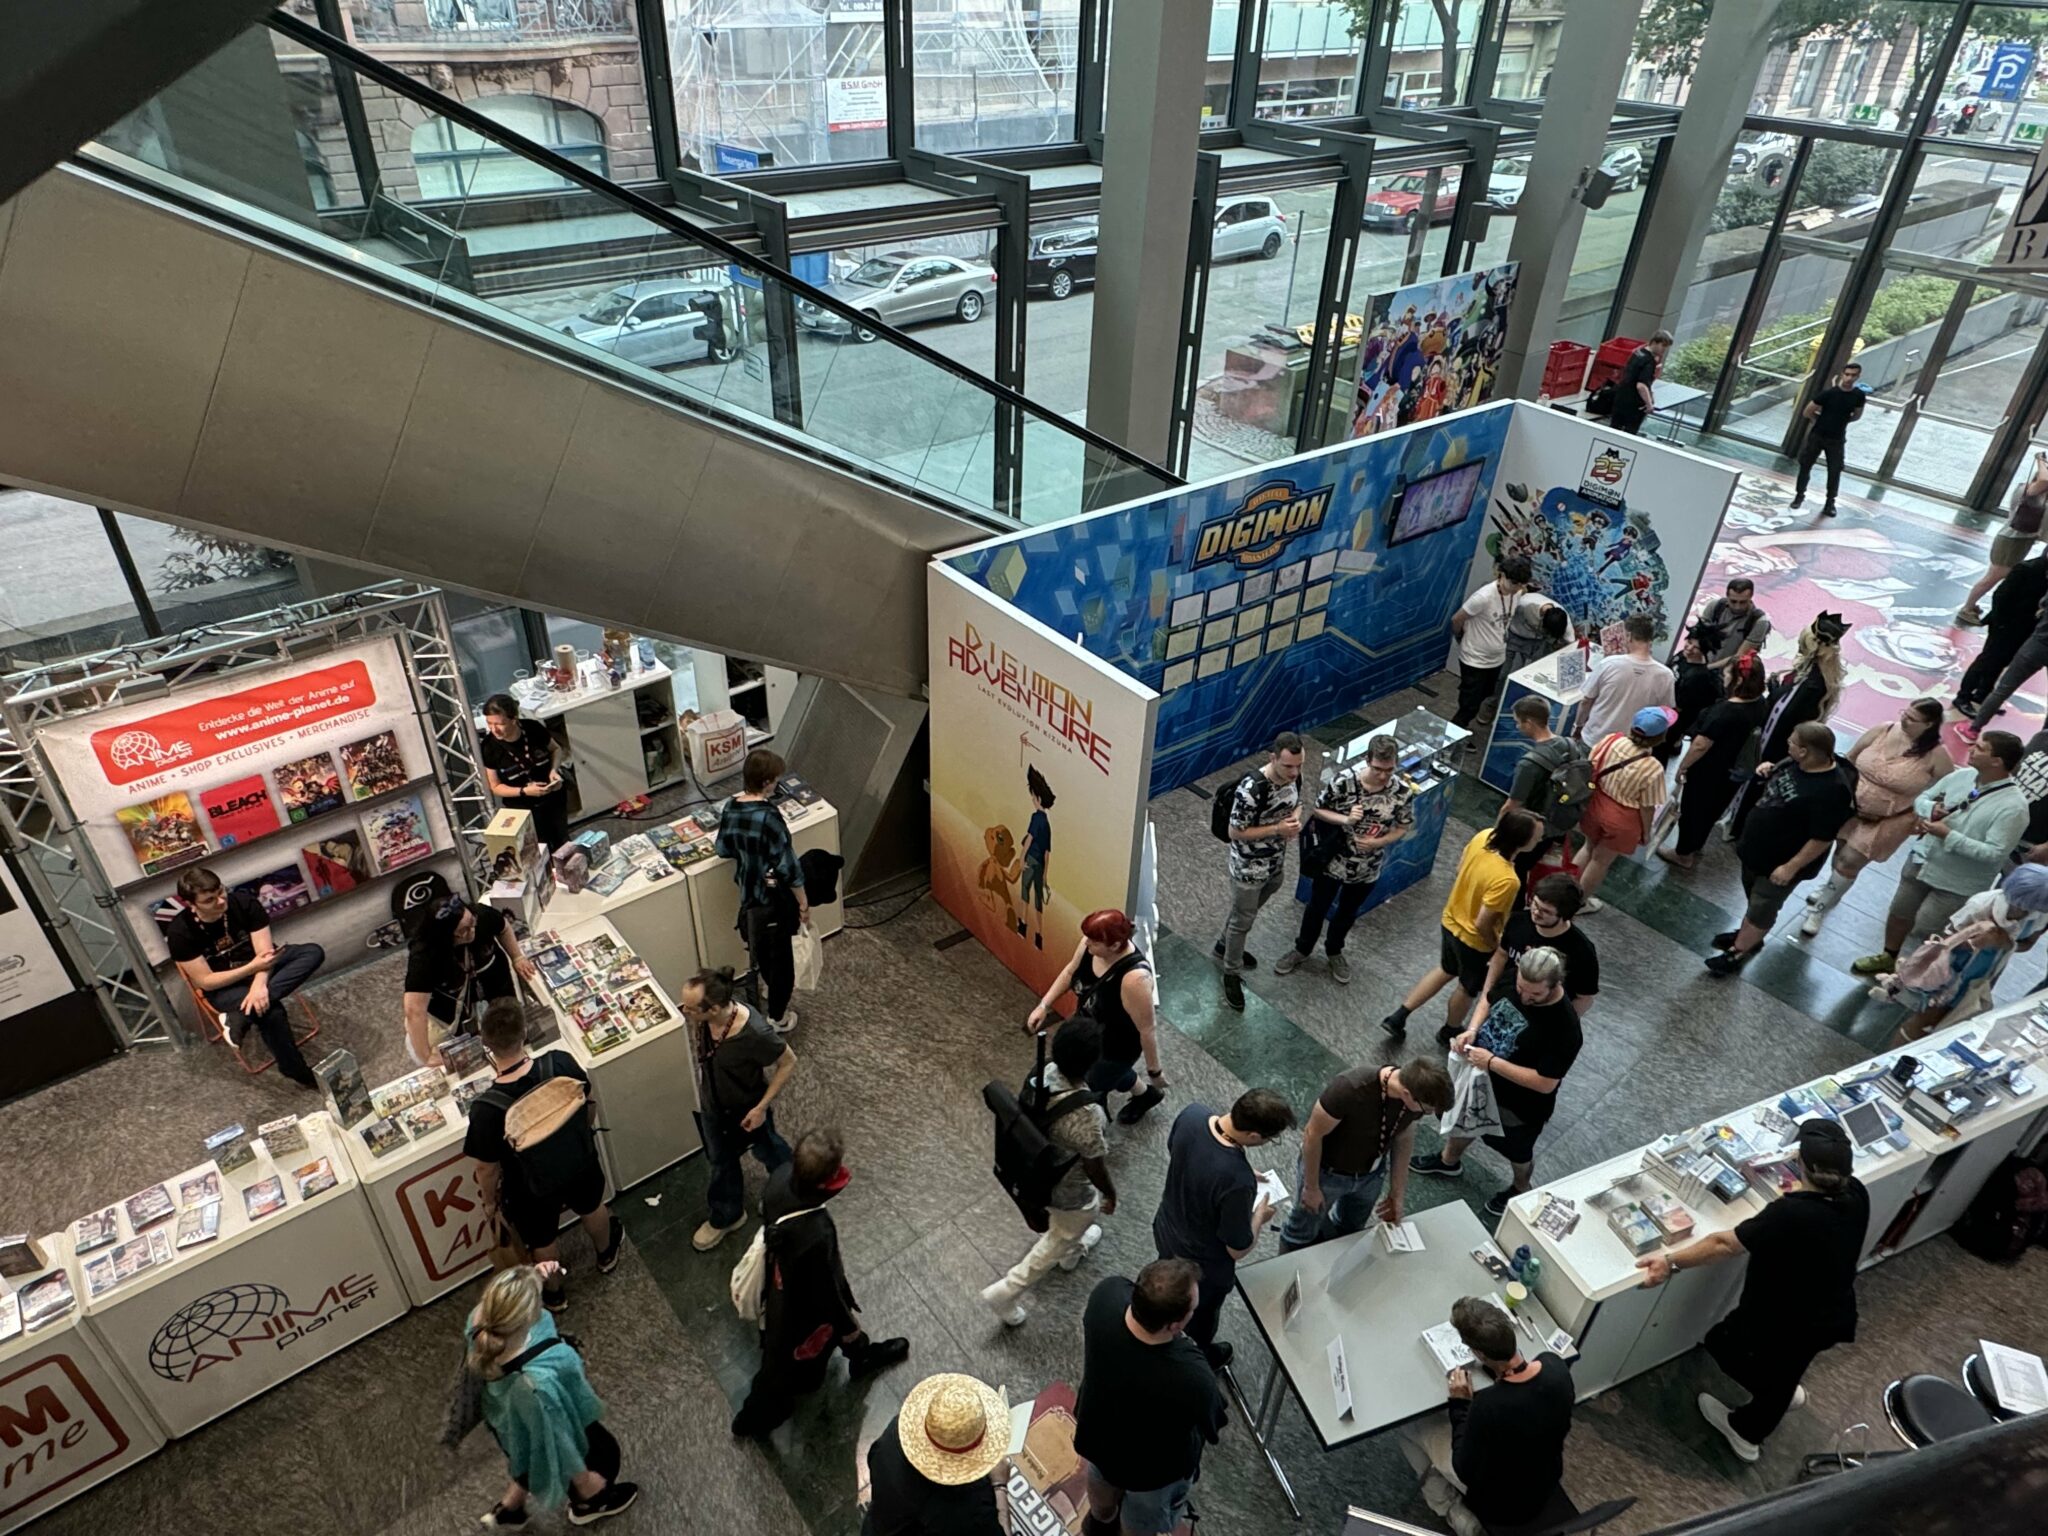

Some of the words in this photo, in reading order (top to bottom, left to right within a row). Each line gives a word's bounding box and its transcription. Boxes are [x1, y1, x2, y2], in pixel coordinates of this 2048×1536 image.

[1992, 62, 2018, 88] P
[1583, 480, 1621, 498] DIGIMON
[1590, 456, 1626, 483] 25
[1197, 493, 1328, 562] DIGIMON
[965, 620, 1095, 727] DIGIMON
[198, 711, 245, 733] Entdecke
[247, 705, 262, 718] die
[264, 699, 285, 713] Welt
[288, 694, 304, 706] der
[308, 684, 338, 700] Anime
[340, 680, 356, 691] auf
[215, 694, 351, 741] www.anime-planet.de
[949, 636, 1112, 776] ADVENTURE
[977, 684, 995, 699] LAST
[998, 698, 1040, 731] EVOLUTION
[1043, 729, 1073, 754] KIZUNA
[124, 739, 192, 770] ANIME
[128, 775, 168, 794] ANIME
[181, 760, 211, 777] SHOP
[216, 737, 286, 766] EXCLUSIVES
[297, 708, 371, 739] MERCHANDISE
[155, 748, 194, 768] planet
[710, 734, 741, 757] KSM
[207, 789, 268, 819] BLEACH
[186, 1273, 377, 1383] ANIME
[276, 1286, 379, 1351] planet
